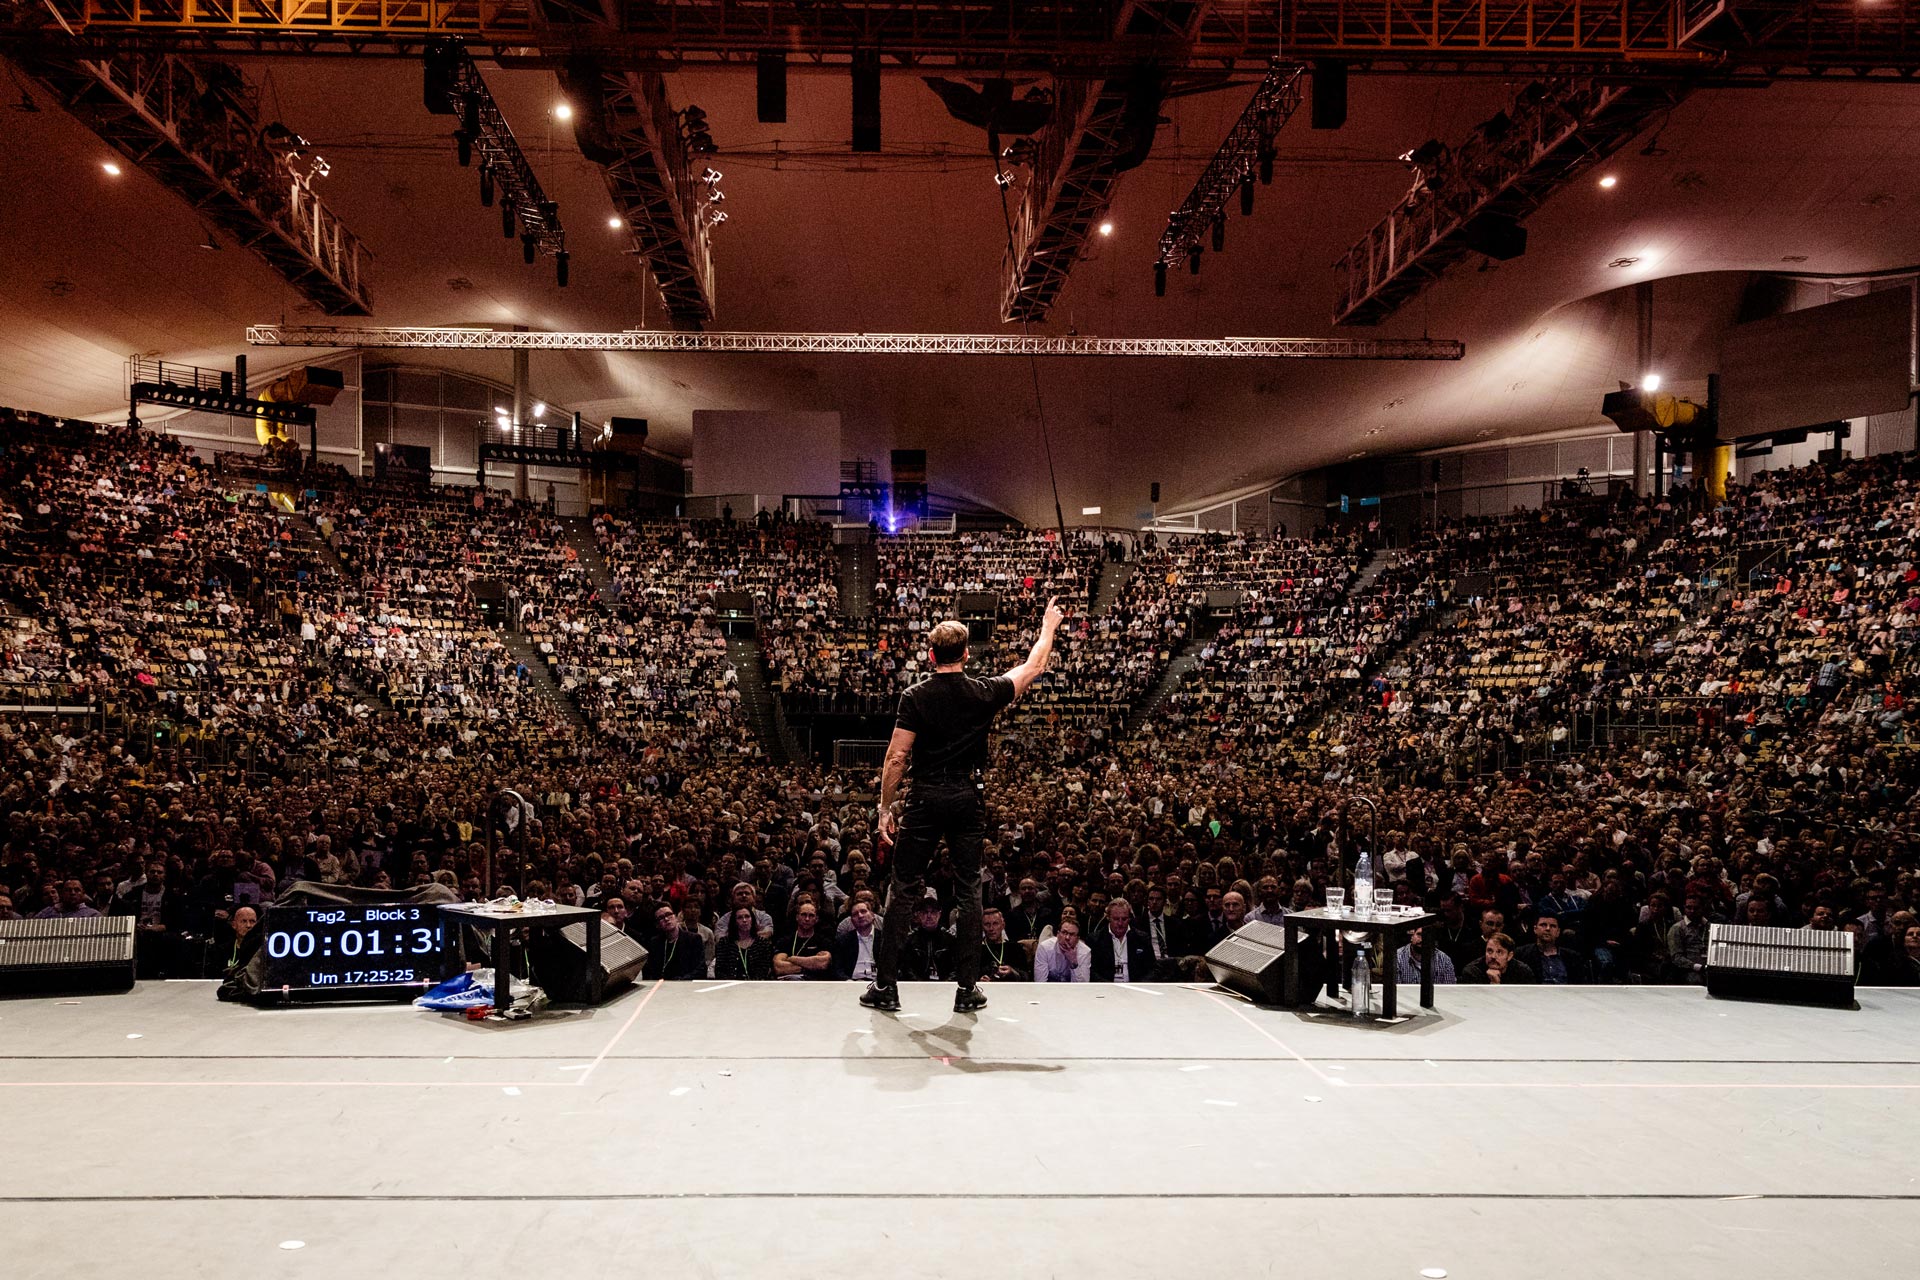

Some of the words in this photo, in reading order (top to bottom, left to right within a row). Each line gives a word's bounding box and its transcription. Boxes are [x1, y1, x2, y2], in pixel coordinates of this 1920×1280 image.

[307, 910, 346, 924] Tag2
[366, 909, 406, 921] Block
[410, 909, 420, 920] 3
[268, 928, 441, 958] 00:01:3
[311, 973, 338, 984] Um
[344, 969, 414, 983] 17:25:25
